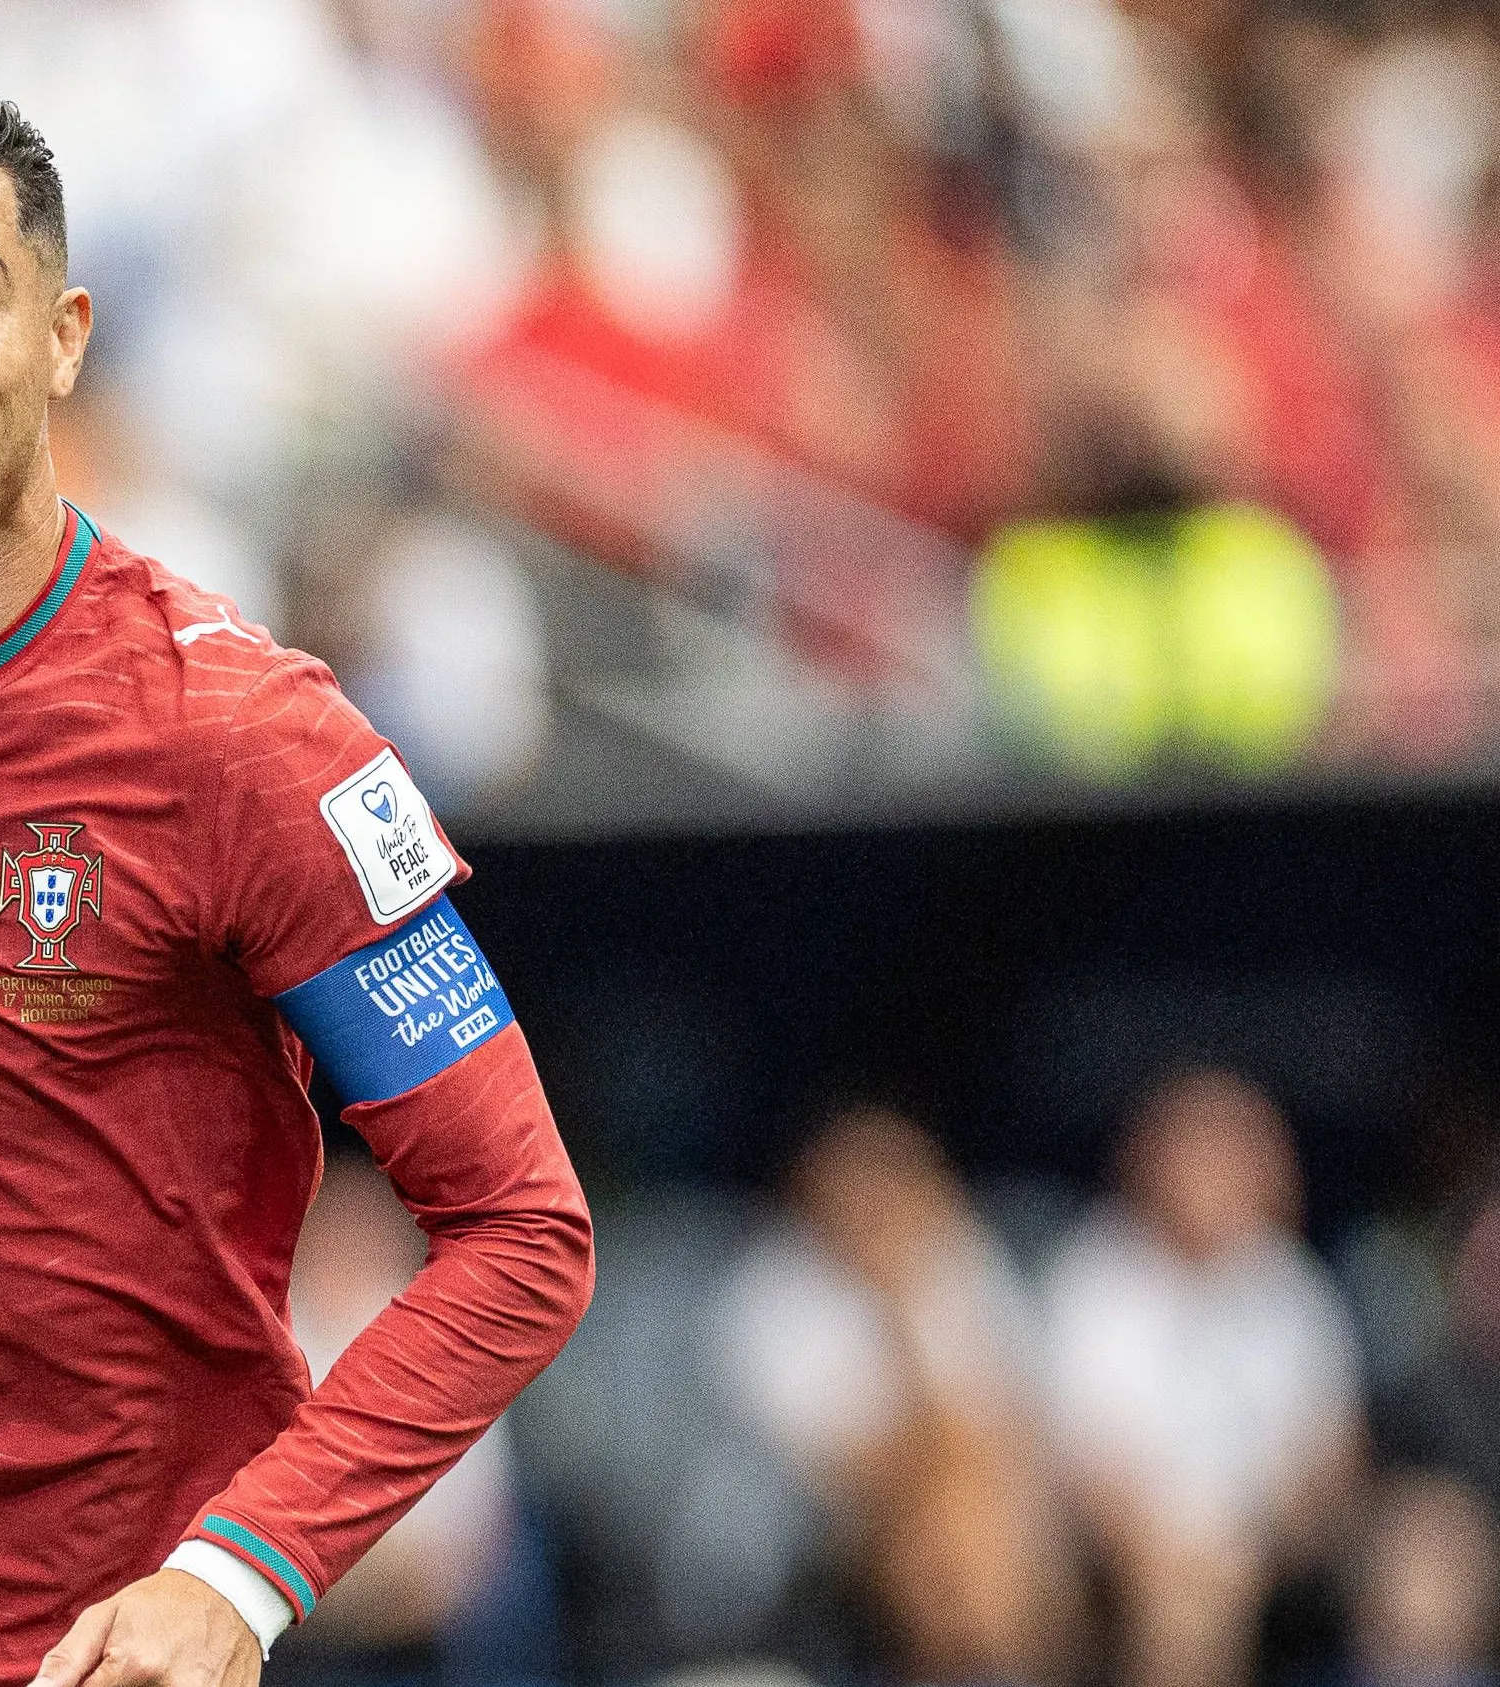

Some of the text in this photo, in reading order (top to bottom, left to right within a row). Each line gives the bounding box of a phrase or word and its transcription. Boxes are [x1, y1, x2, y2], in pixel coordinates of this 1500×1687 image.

[376, 827, 407, 860] Unite
[389, 838, 429, 881] PEACE
[408, 868, 431, 890] FIFA
[354, 913, 456, 990] FOOTBALL
[369, 933, 477, 1017] UNITES
[4, 993, 17, 1007] 17
[20, 1008, 89, 1023] HOUSTON
[391, 961, 499, 1047] the World
[455, 1010, 494, 1042] FIFA
